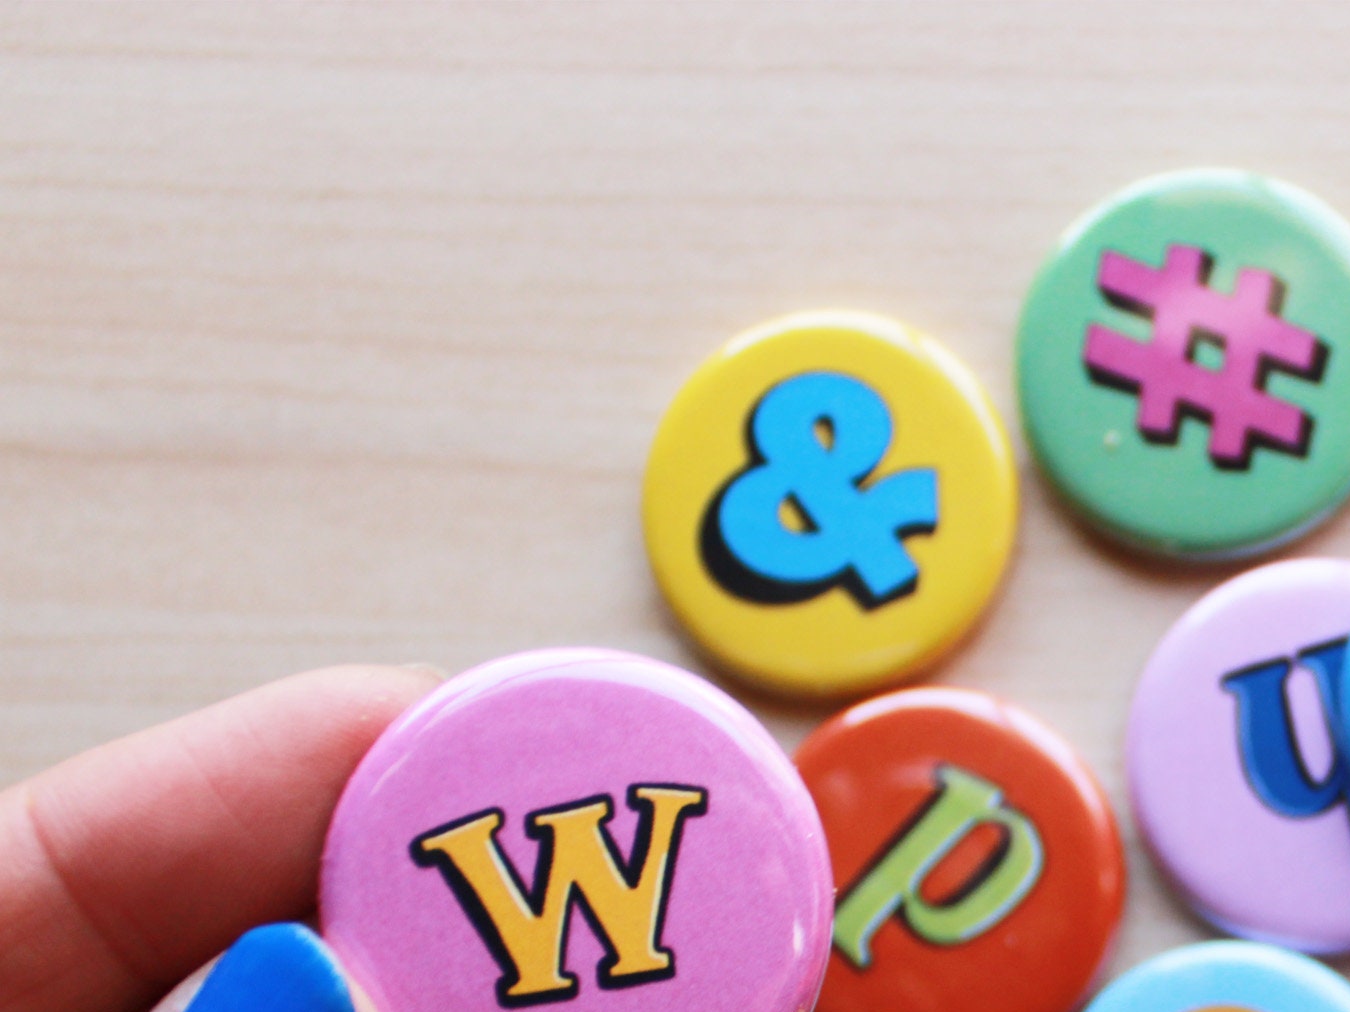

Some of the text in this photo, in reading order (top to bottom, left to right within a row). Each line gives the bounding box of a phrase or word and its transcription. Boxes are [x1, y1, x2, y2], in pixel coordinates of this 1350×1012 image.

[1082, 244, 1330, 471] #
[696, 371, 938, 613] &
[832, 762, 1044, 970] p
